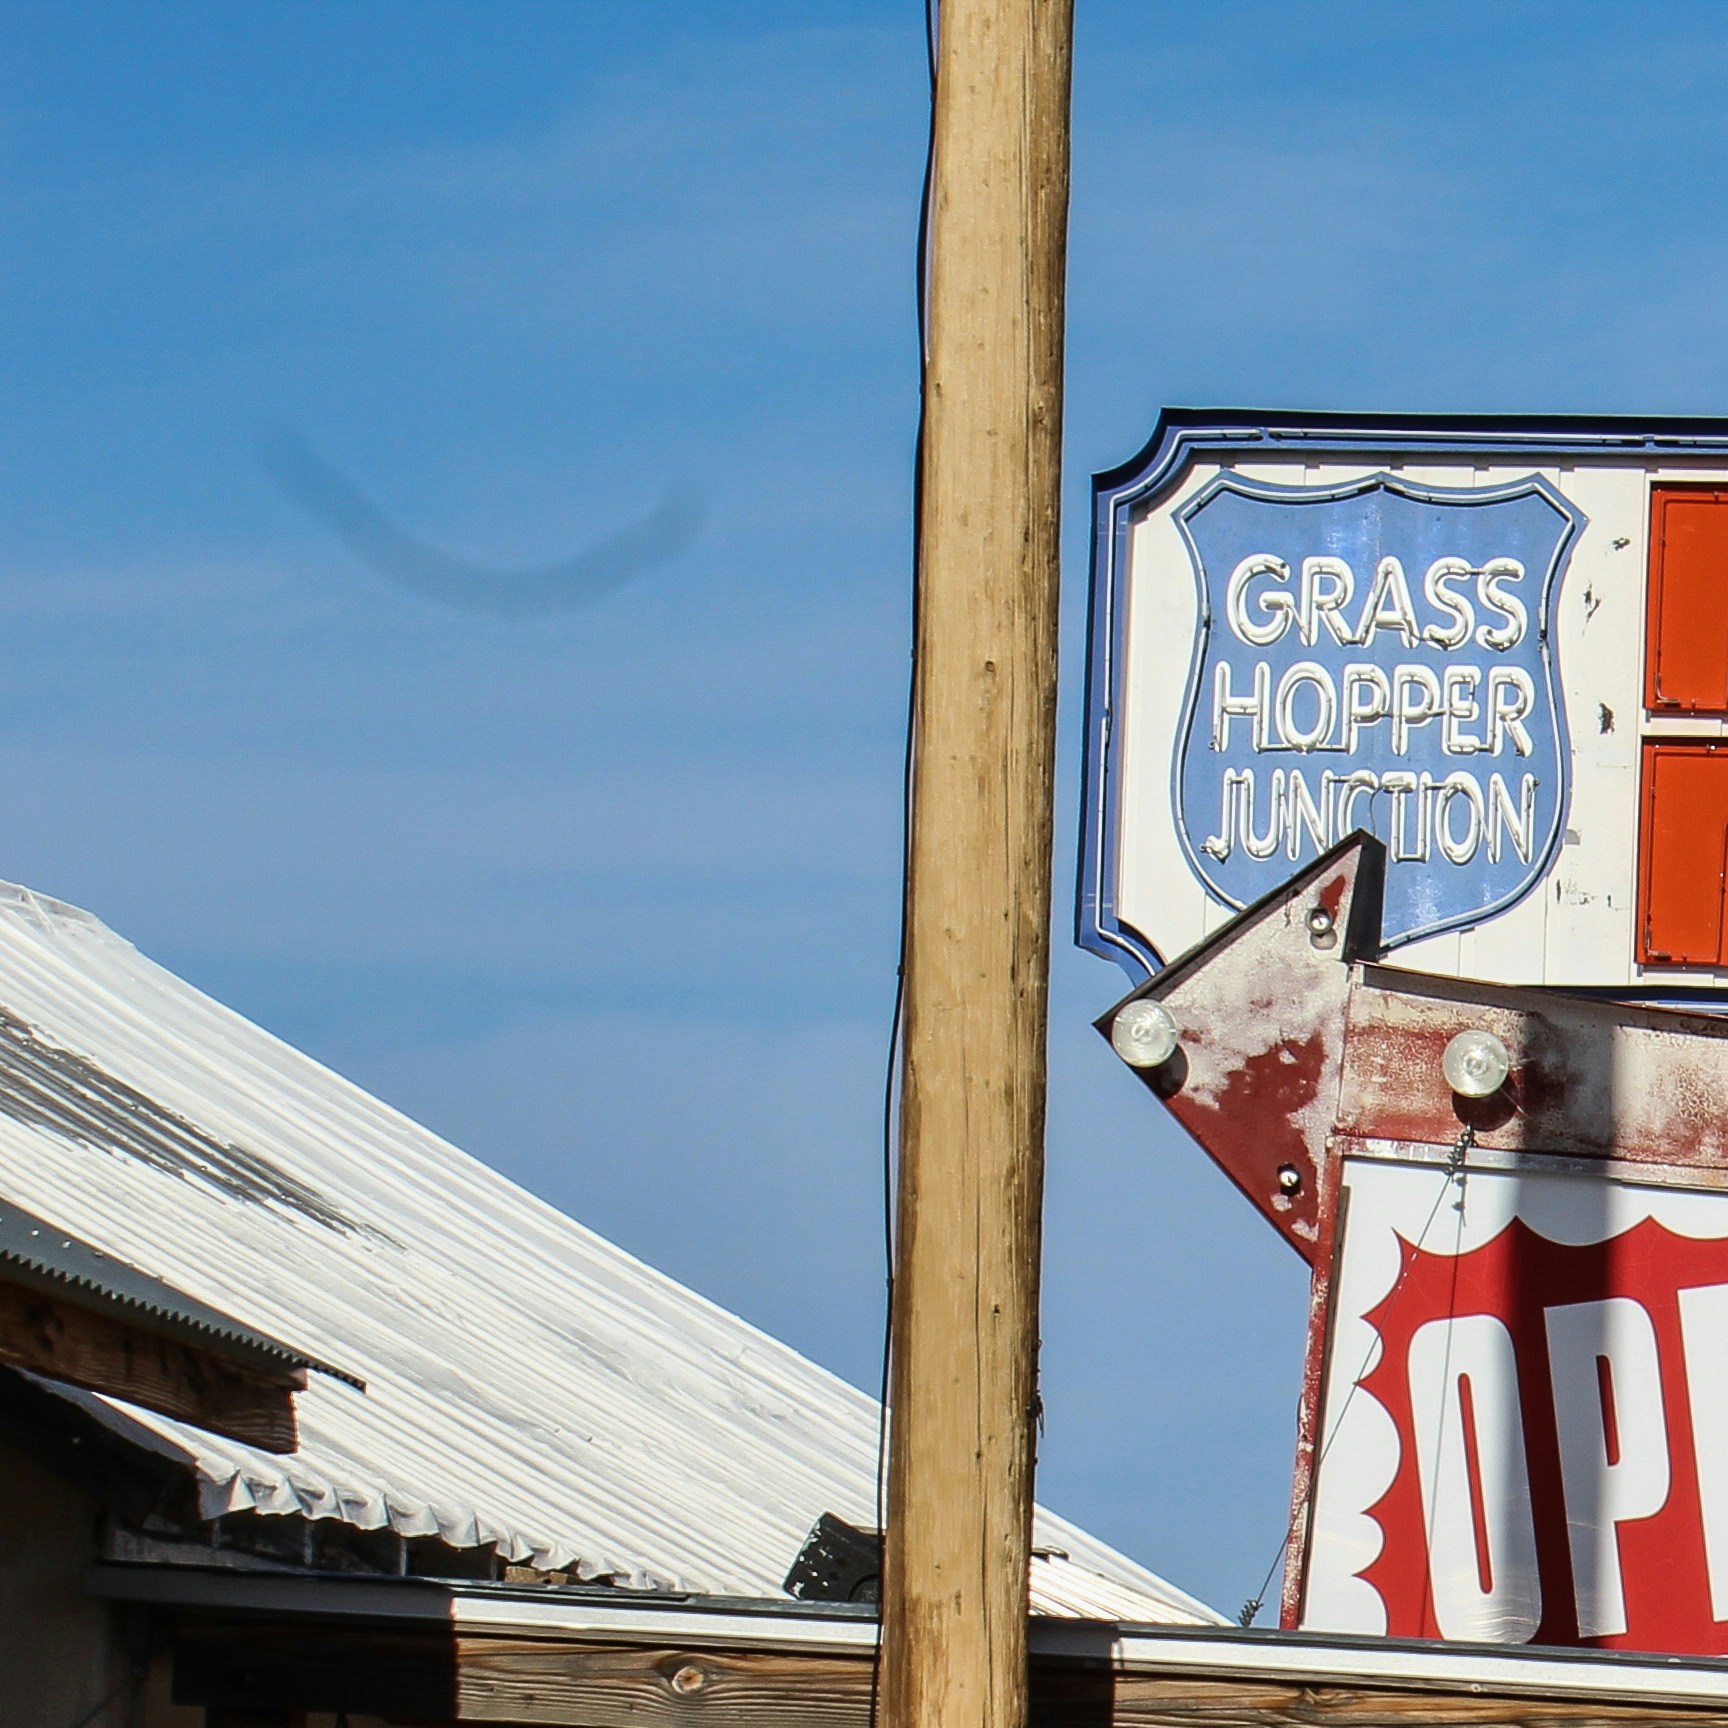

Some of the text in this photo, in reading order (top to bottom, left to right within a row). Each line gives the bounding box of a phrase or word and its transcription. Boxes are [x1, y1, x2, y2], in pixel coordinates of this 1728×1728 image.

[1226, 554, 1527, 650] GRASS
[1210, 660, 1536, 757] HOPPER
[1200, 767, 1538, 865] JUNCTION
